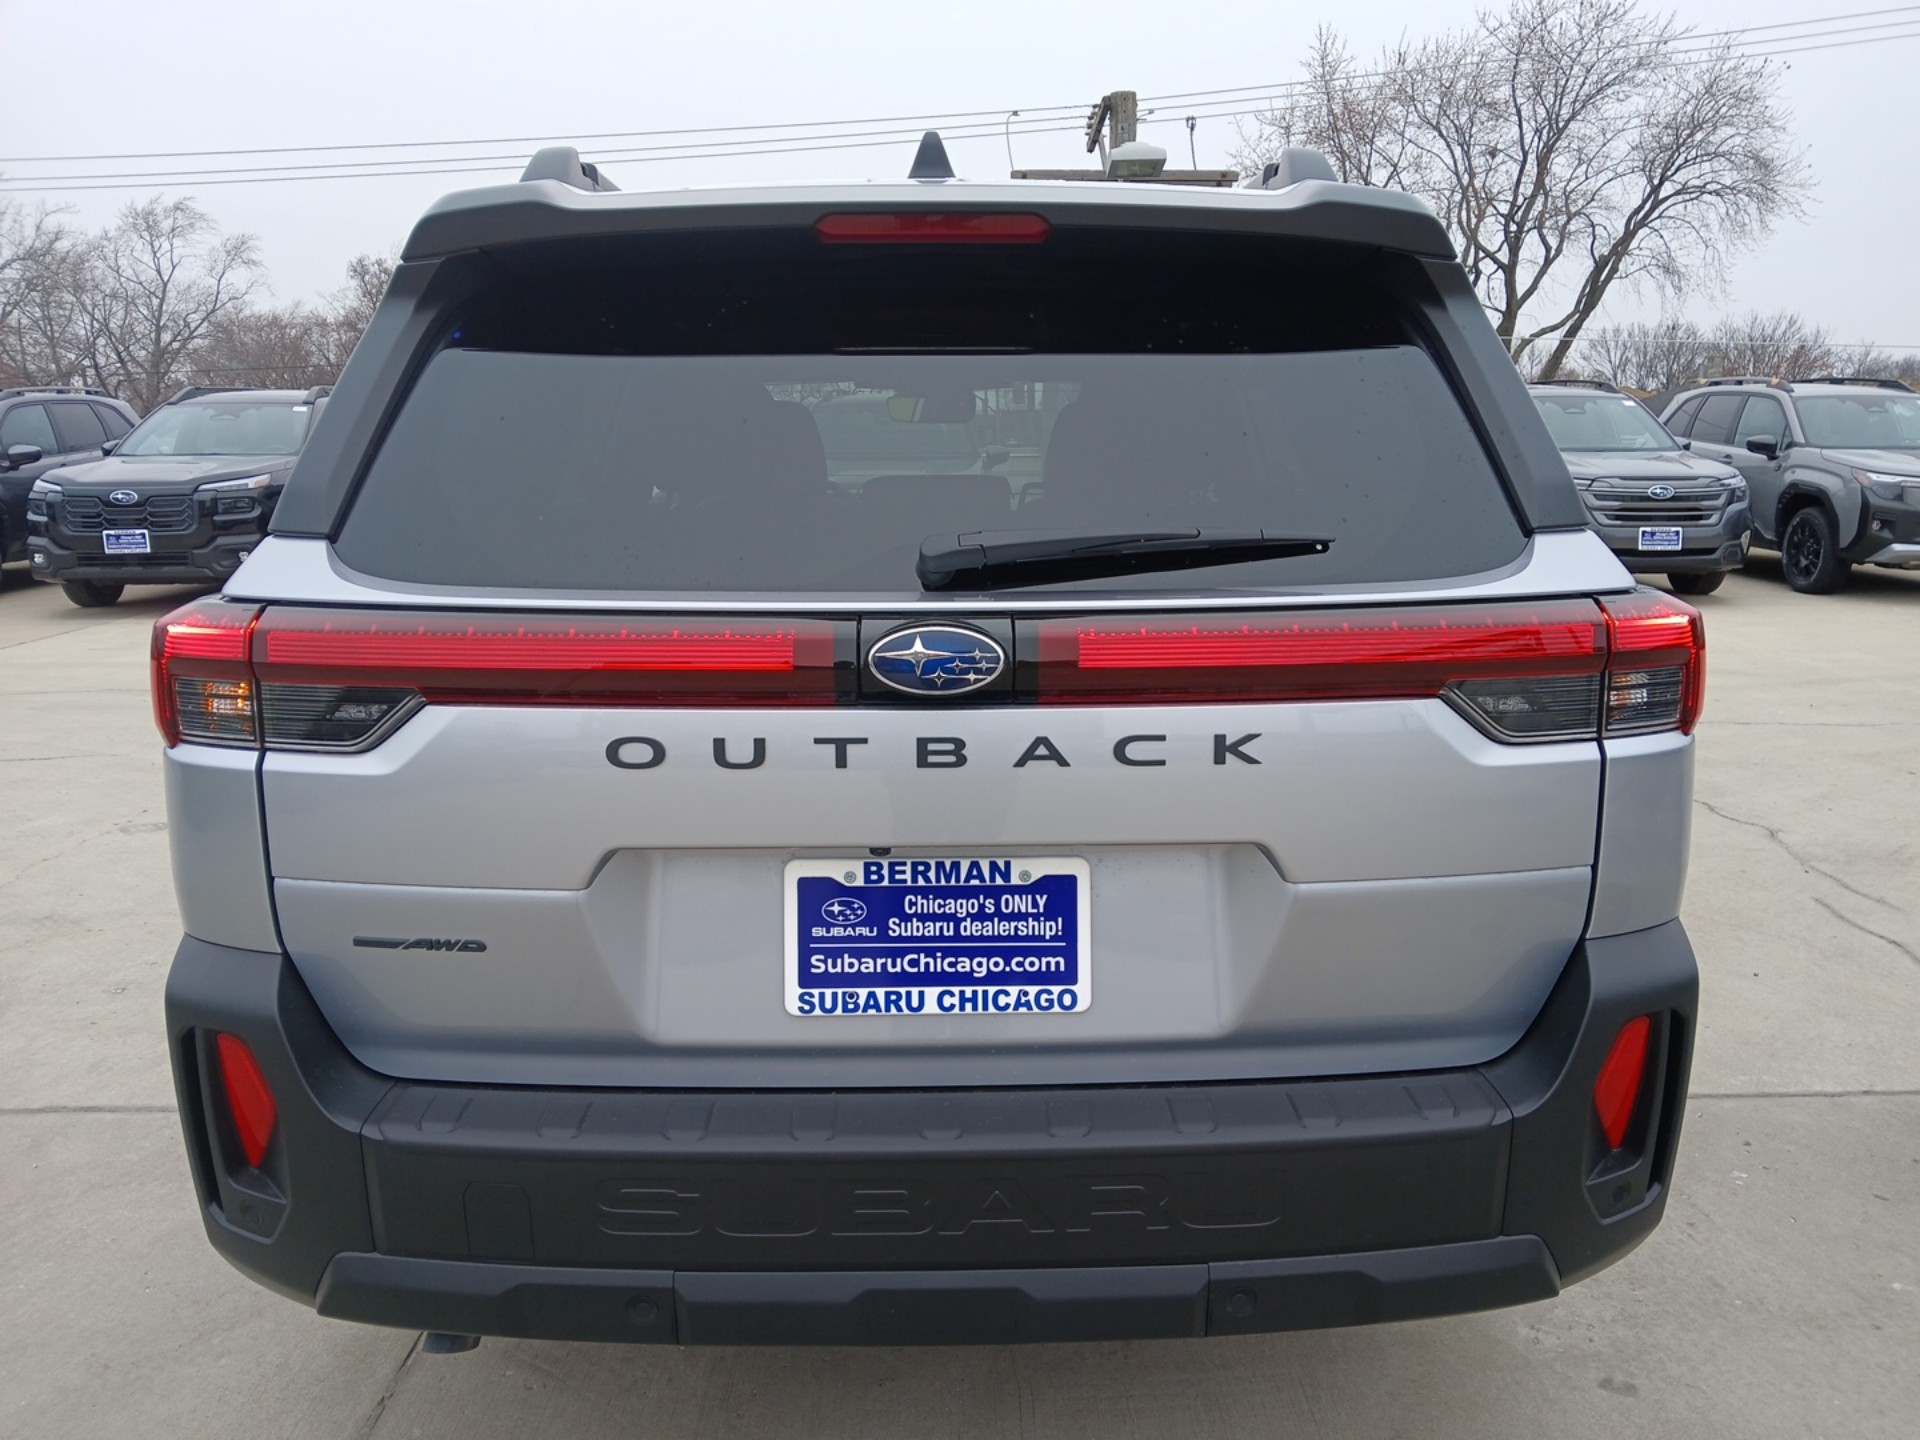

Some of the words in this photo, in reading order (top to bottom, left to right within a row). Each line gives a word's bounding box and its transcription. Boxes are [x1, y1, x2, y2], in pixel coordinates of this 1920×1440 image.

[605, 733, 1262, 770] OUTBACK
[863, 860, 1011, 885] BERMAN
[904, 895, 995, 916] Chicago's
[1001, 894, 1047, 914] ONLY
[811, 927, 877, 937] SUBARU
[888, 918, 954, 937] Subaru
[960, 917, 1062, 939] dealership!
[402, 938, 487, 952] AWD
[810, 954, 1065, 977] SubaruChicago.com
[798, 989, 925, 1015] SUBARU
[937, 988, 1078, 1013] CHICAGO
